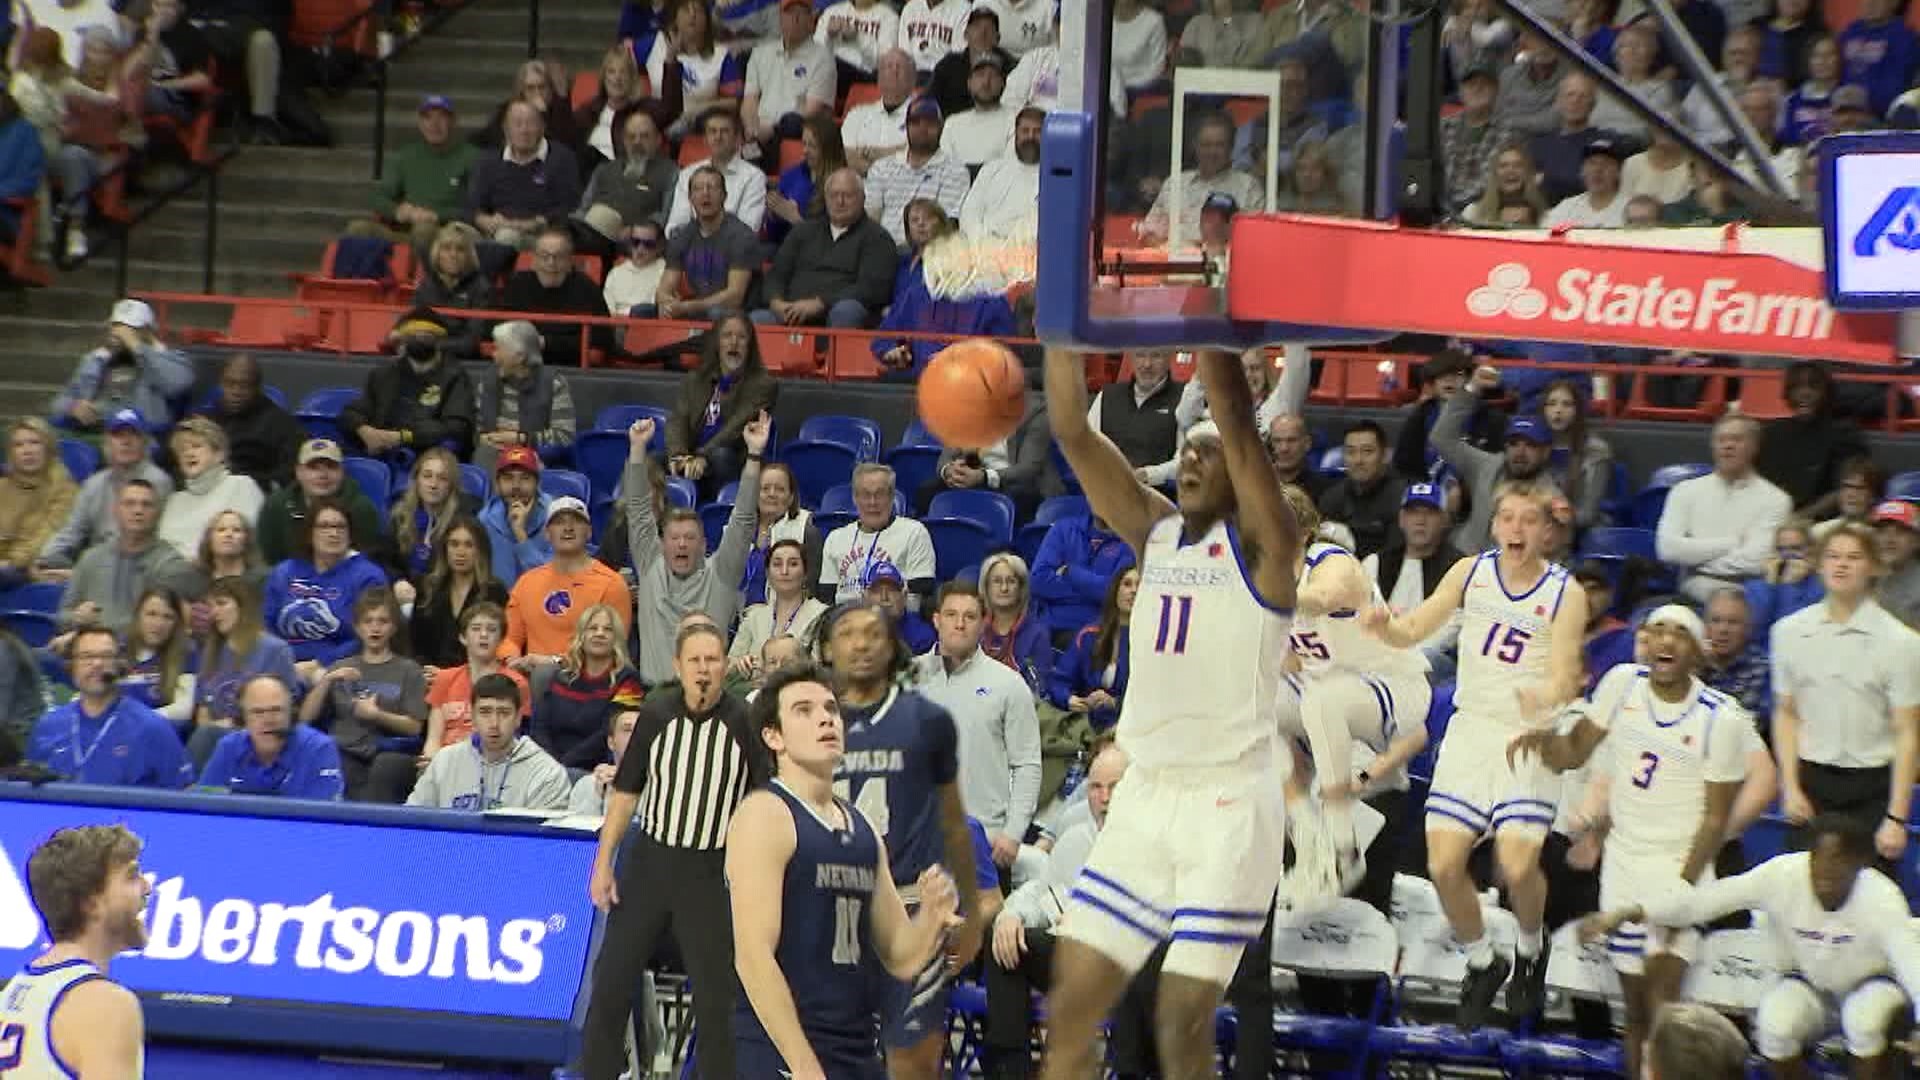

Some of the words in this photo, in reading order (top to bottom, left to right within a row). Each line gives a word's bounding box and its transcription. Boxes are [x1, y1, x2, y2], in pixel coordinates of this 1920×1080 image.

[1154, 593, 1193, 656] 11
[1481, 621, 1533, 665] 15
[832, 748, 905, 774] EVADA
[1631, 750, 1659, 790] 3
